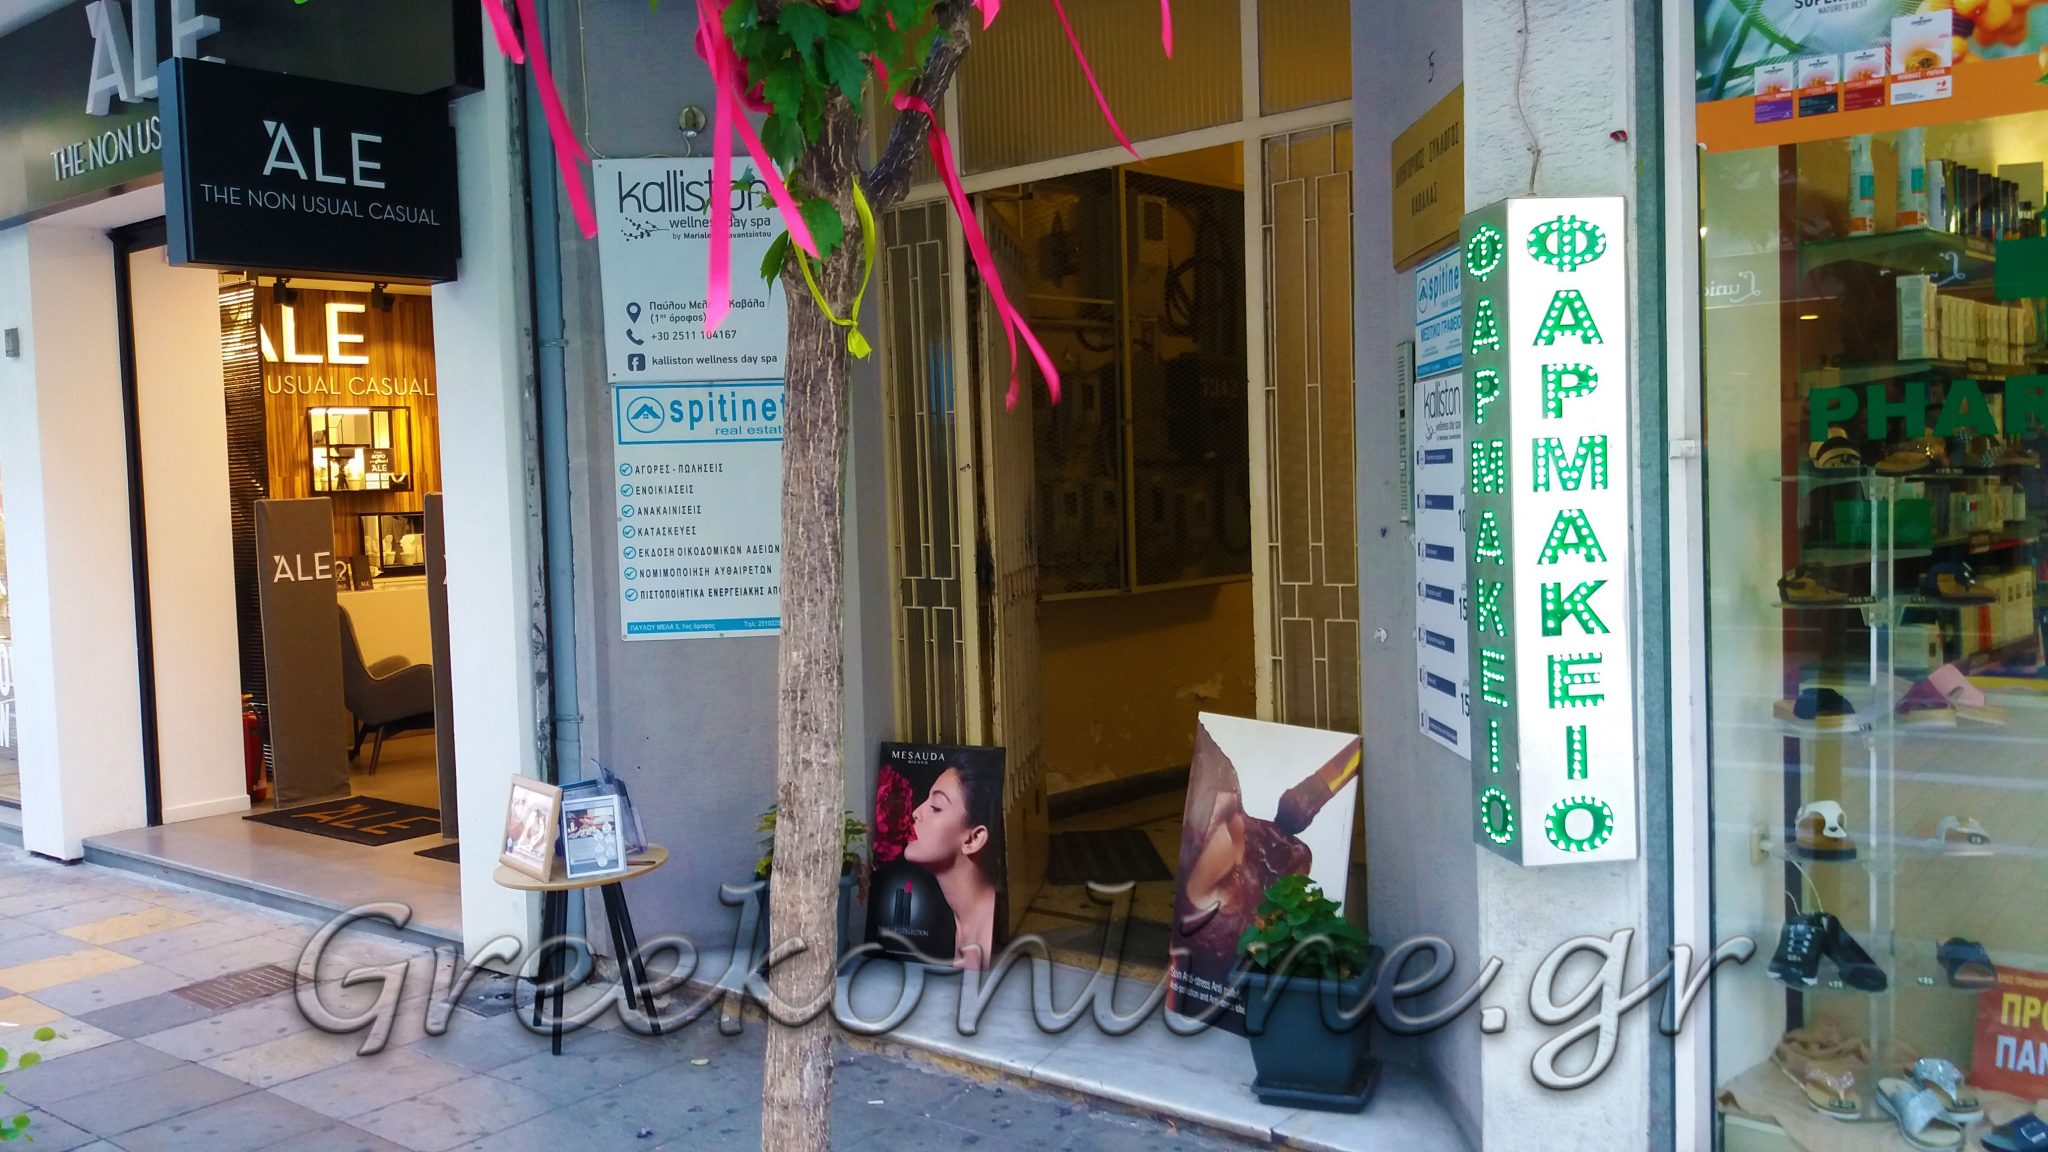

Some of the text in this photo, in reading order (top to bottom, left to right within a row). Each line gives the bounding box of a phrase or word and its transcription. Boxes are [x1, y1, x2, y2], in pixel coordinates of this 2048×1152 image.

[50, 141, 86, 181] THE
[88, 125, 134, 170] NON
[200, 183, 440, 226] THE NON USUAL CASUAL
[750, 217, 771, 230] spa
[672, 233, 681, 241] by
[684, 232, 711, 240] Marialo
[1429, 263, 1459, 307] spitine
[689, 300, 709, 310] Μελ
[651, 329, 737, 342] +30 2511 104167
[652, 354, 777, 366] kalliston wellness day spa
[267, 375, 435, 396] USUAL CASUAL
[1424, 380, 1460, 419] kalliston
[715, 425, 784, 435] real estat
[371, 464, 388, 472] ALE
[635, 465, 670, 475] ΑΓΟΡΕΣ
[678, 463, 724, 474] ΠΩΛΗΣΕΙΣ
[635, 484, 694, 496] ΕΝΟΙΚΙΑΣΕΙΣ
[637, 505, 702, 516] ΑΝΑΚΑΙΝΙΣΕΙΣ
[637, 526, 697, 537] ΚΑΤΑΣΚΕΥΕΣ
[1467, 224, 1513, 845] ΦΑΡΜΑΚΕΙΟ
[1527, 215, 1614, 853] ΦΑΡΜΑΚΕΙΟ
[638, 544, 780, 558] ΕΚΔΟΣΗ ΟΙΚΟΔΟΜΙΚΩΝ ΑΔΕΙΩΝ
[639, 564, 772, 578] ΝΟΜΙΜΟΠΟΙΗΣΗ ΑΥΘΑΙΡΕΤΩΝ
[640, 588, 705, 600] ΠΙΣΤΟΠΟΙΗΤΙΚΑ
[708, 587, 764, 598] ΕΝΕΡΓΕΙΑΚΗΣ
[891, 750, 945, 761] MESAUDA
